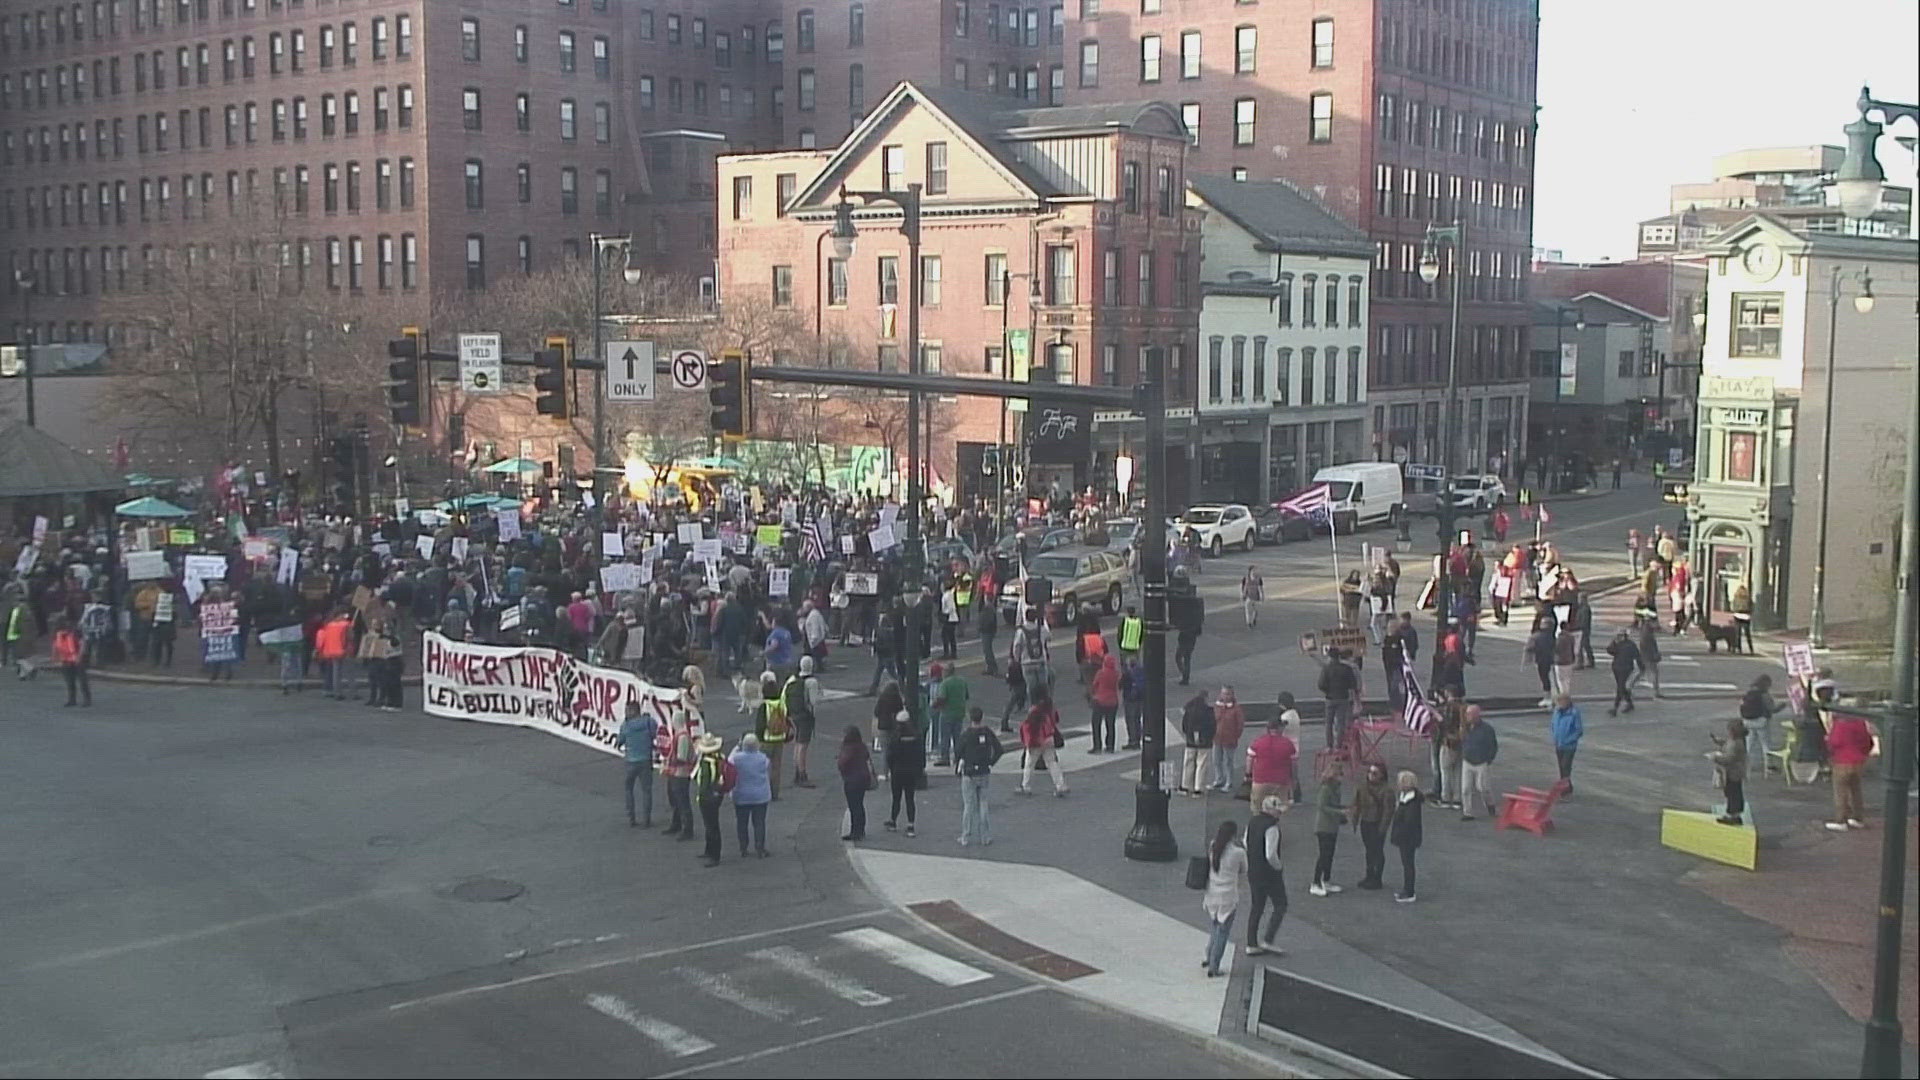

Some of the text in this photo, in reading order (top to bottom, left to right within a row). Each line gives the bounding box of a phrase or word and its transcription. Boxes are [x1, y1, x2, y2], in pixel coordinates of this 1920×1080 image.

[471, 348, 490, 358] YIELD
[614, 383, 647, 396] ONLY
[464, 694, 521, 714] BUILD
